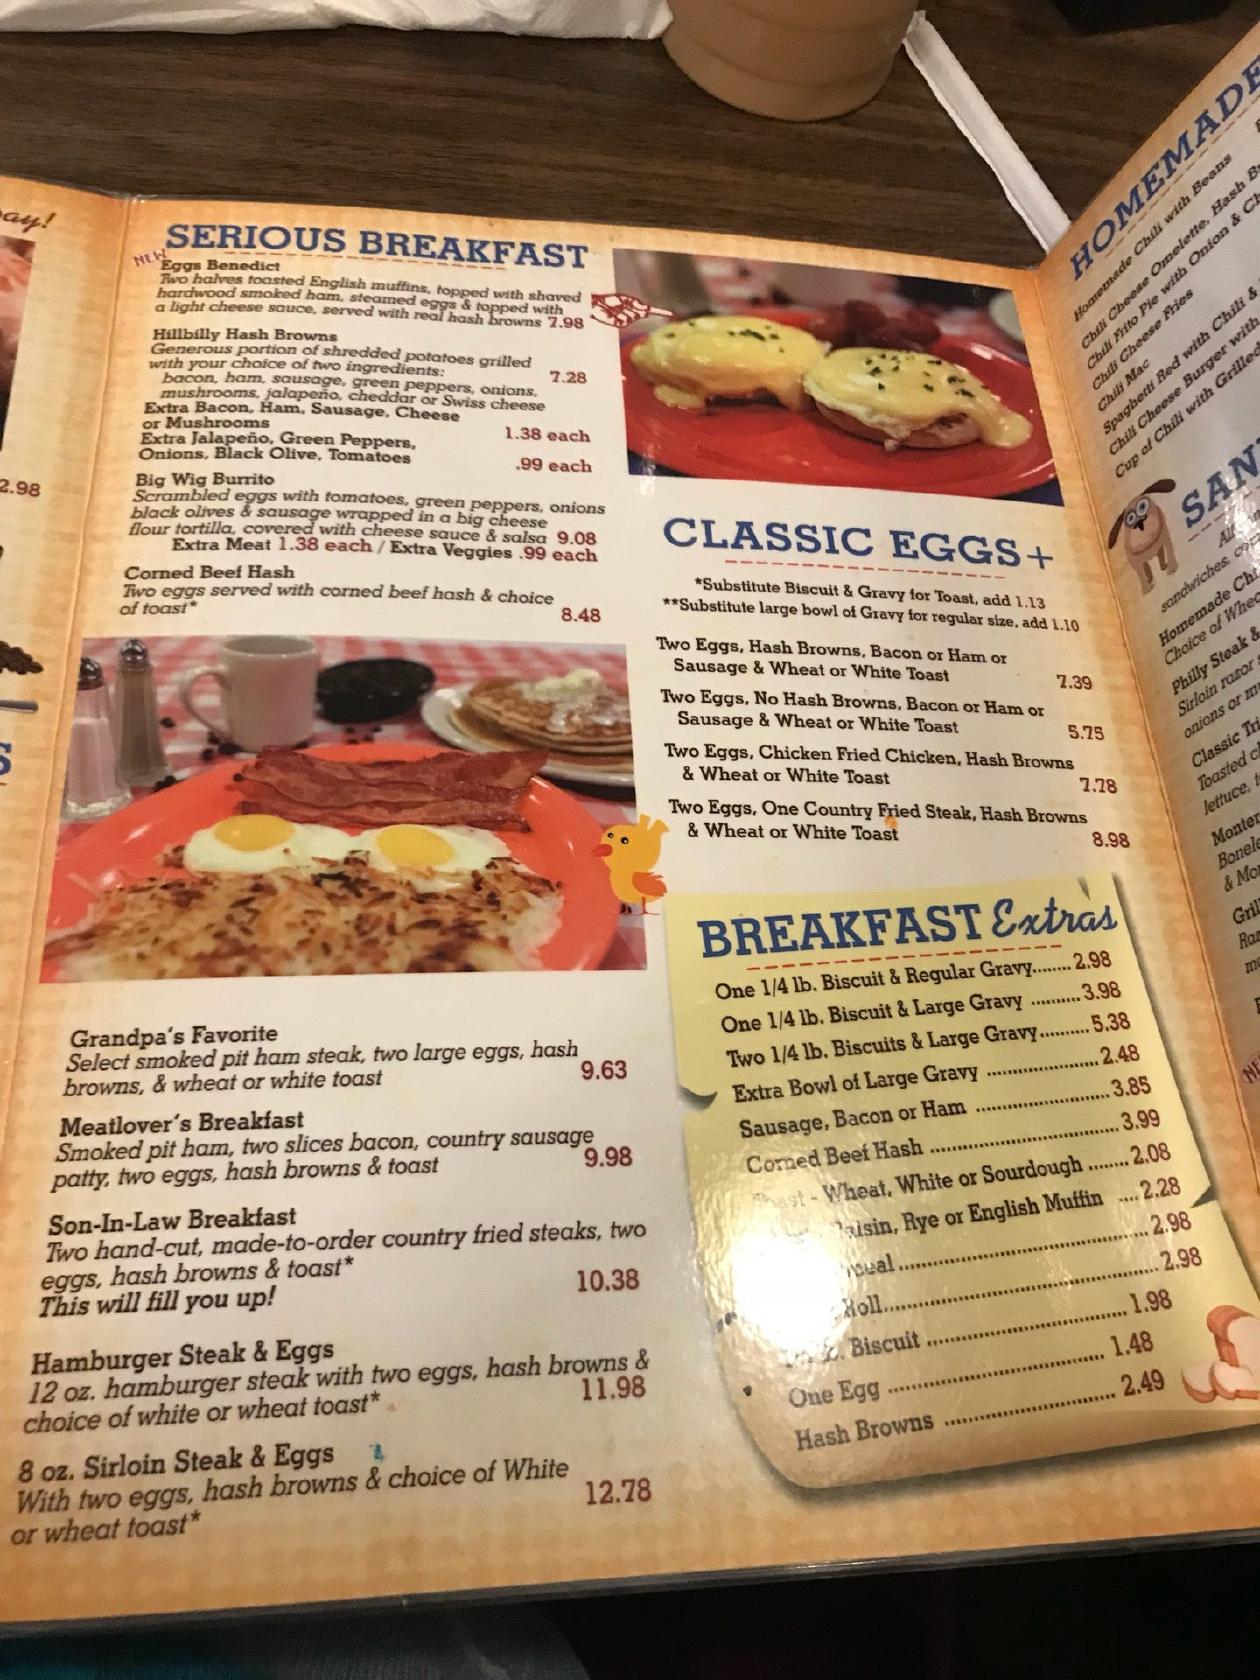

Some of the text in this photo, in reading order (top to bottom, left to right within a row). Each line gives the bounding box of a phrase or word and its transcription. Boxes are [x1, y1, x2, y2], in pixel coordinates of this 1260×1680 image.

[0, 208, 56, 233] ay!
[165, 222, 589, 269] SERIOUS BREAKFAST
[1073, 153, 1232, 323] Homemade Chili with Beans
[134, 248, 167, 267] NEW
[160, 258, 281, 274] Eggs Benedict
[1080, 317, 1108, 350] Chili
[1107, 276, 1150, 321] Cheese
[1210, 180, 1247, 217] Hash
[159, 272, 189, 285] Two
[191, 272, 244, 285] halves
[247, 274, 306, 286] toasted
[308, 275, 367, 291] English
[435, 284, 490, 299] topped
[492, 288, 524, 301] with
[527, 289, 582, 304] shaved
[1086, 212, 1242, 370] Chili Frito Pie with Onion &
[151, 327, 338, 343] Hillbilly Hash Browns
[547, 315, 585, 330] 7.98
[1092, 288, 1194, 391] Chili Cheese Fries
[548, 369, 588, 385] 7.28
[1097, 358, 1150, 412] Chili Mac
[139, 431, 187, 446] Extra
[279, 432, 336, 447] Green
[505, 425, 591, 443] 1.38 each
[1116, 455, 1139, 478] Cup
[1141, 438, 1152, 455] of
[1154, 411, 1184, 442] Chili
[1186, 388, 1214, 415] with
[515, 456, 593, 473] .99 each
[135, 471, 276, 489] Big Wig Burrito
[556, 530, 597, 546] 9.08
[662, 516, 874, 557] CLASSIC
[123, 564, 296, 581] Corned Beef Hash
[783, 582, 840, 597] Biscuit
[842, 584, 854, 598] &
[856, 585, 906, 603] Gravy
[908, 588, 931, 601] for
[982, 593, 1012, 607] add
[1015, 595, 1046, 610] 1.13
[560, 606, 601, 623] 8.48
[1157, 589, 1231, 648] Homemade
[654, 635, 691, 651] Two
[747, 638, 794, 655] Hash
[869, 643, 923, 660] Bacon
[926, 650, 944, 662] or
[946, 647, 987, 663] Ham
[990, 653, 1008, 665] or
[1164, 618, 1223, 666] Choice of
[1170, 625, 1260, 696] Philly Steak &
[1055, 673, 1093, 690] 7.39
[1177, 659, 1254, 718] Sirloin razor
[1067, 723, 1105, 741] 5.75
[1191, 731, 1241, 768] Classic
[1196, 750, 1248, 792] Toasted
[1078, 776, 1118, 794] 7.78
[1091, 830, 1131, 849] 8.98
[698, 897, 1117, 957] BREAKFAST Extras
[1072, 949, 1112, 970] 2.98
[1080, 980, 1122, 1001] 3.98
[720, 992, 1023, 1034] One 1/4 lb. Biscuit & Large Gravy
[1090, 1011, 1131, 1033] 5.38
[190, 1024, 278, 1045] Favorite
[1099, 1043, 1141, 1065] 2.48
[580, 1059, 628, 1081] 9.63
[1110, 1075, 1152, 1098] 3.85
[198, 1110, 305, 1132] Breakfast
[831, 1108, 894, 1129] Bacon
[897, 1106, 917, 1122] or
[919, 1098, 968, 1118] Ham
[1120, 1108, 1161, 1131] 3.99
[583, 1145, 633, 1168] 9.98
[745, 1136, 924, 1174] Corned Beef Hash
[1129, 1141, 1172, 1166] 2.08
[894, 1172, 954, 1194] White
[957, 1171, 978, 1187] or
[980, 1154, 1084, 1184] Sourdough
[1136, 1175, 1182, 1201] 2.28
[47, 1206, 297, 1236] Son-In-Law Breakfast
[1149, 1211, 1192, 1236] 2.98
[1160, 1246, 1203, 1272] 2.98
[576, 1267, 640, 1293] 10.38
[1128, 1289, 1173, 1314] 1.98
[30, 1338, 334, 1376] Hamburger Steak & Eggs
[846, 1330, 921, 1359] Biscuit
[1109, 1332, 1154, 1357] 1.48
[581, 1374, 646, 1402] 11.98
[787, 1380, 880, 1409] One Egg
[1120, 1371, 1165, 1397] 2.49
[793, 1414, 935, 1452] Hash Browns
[17, 1442, 334, 1484] 8 oz. Sirloin Steak & Eggs
[585, 1477, 652, 1506] 12.78
